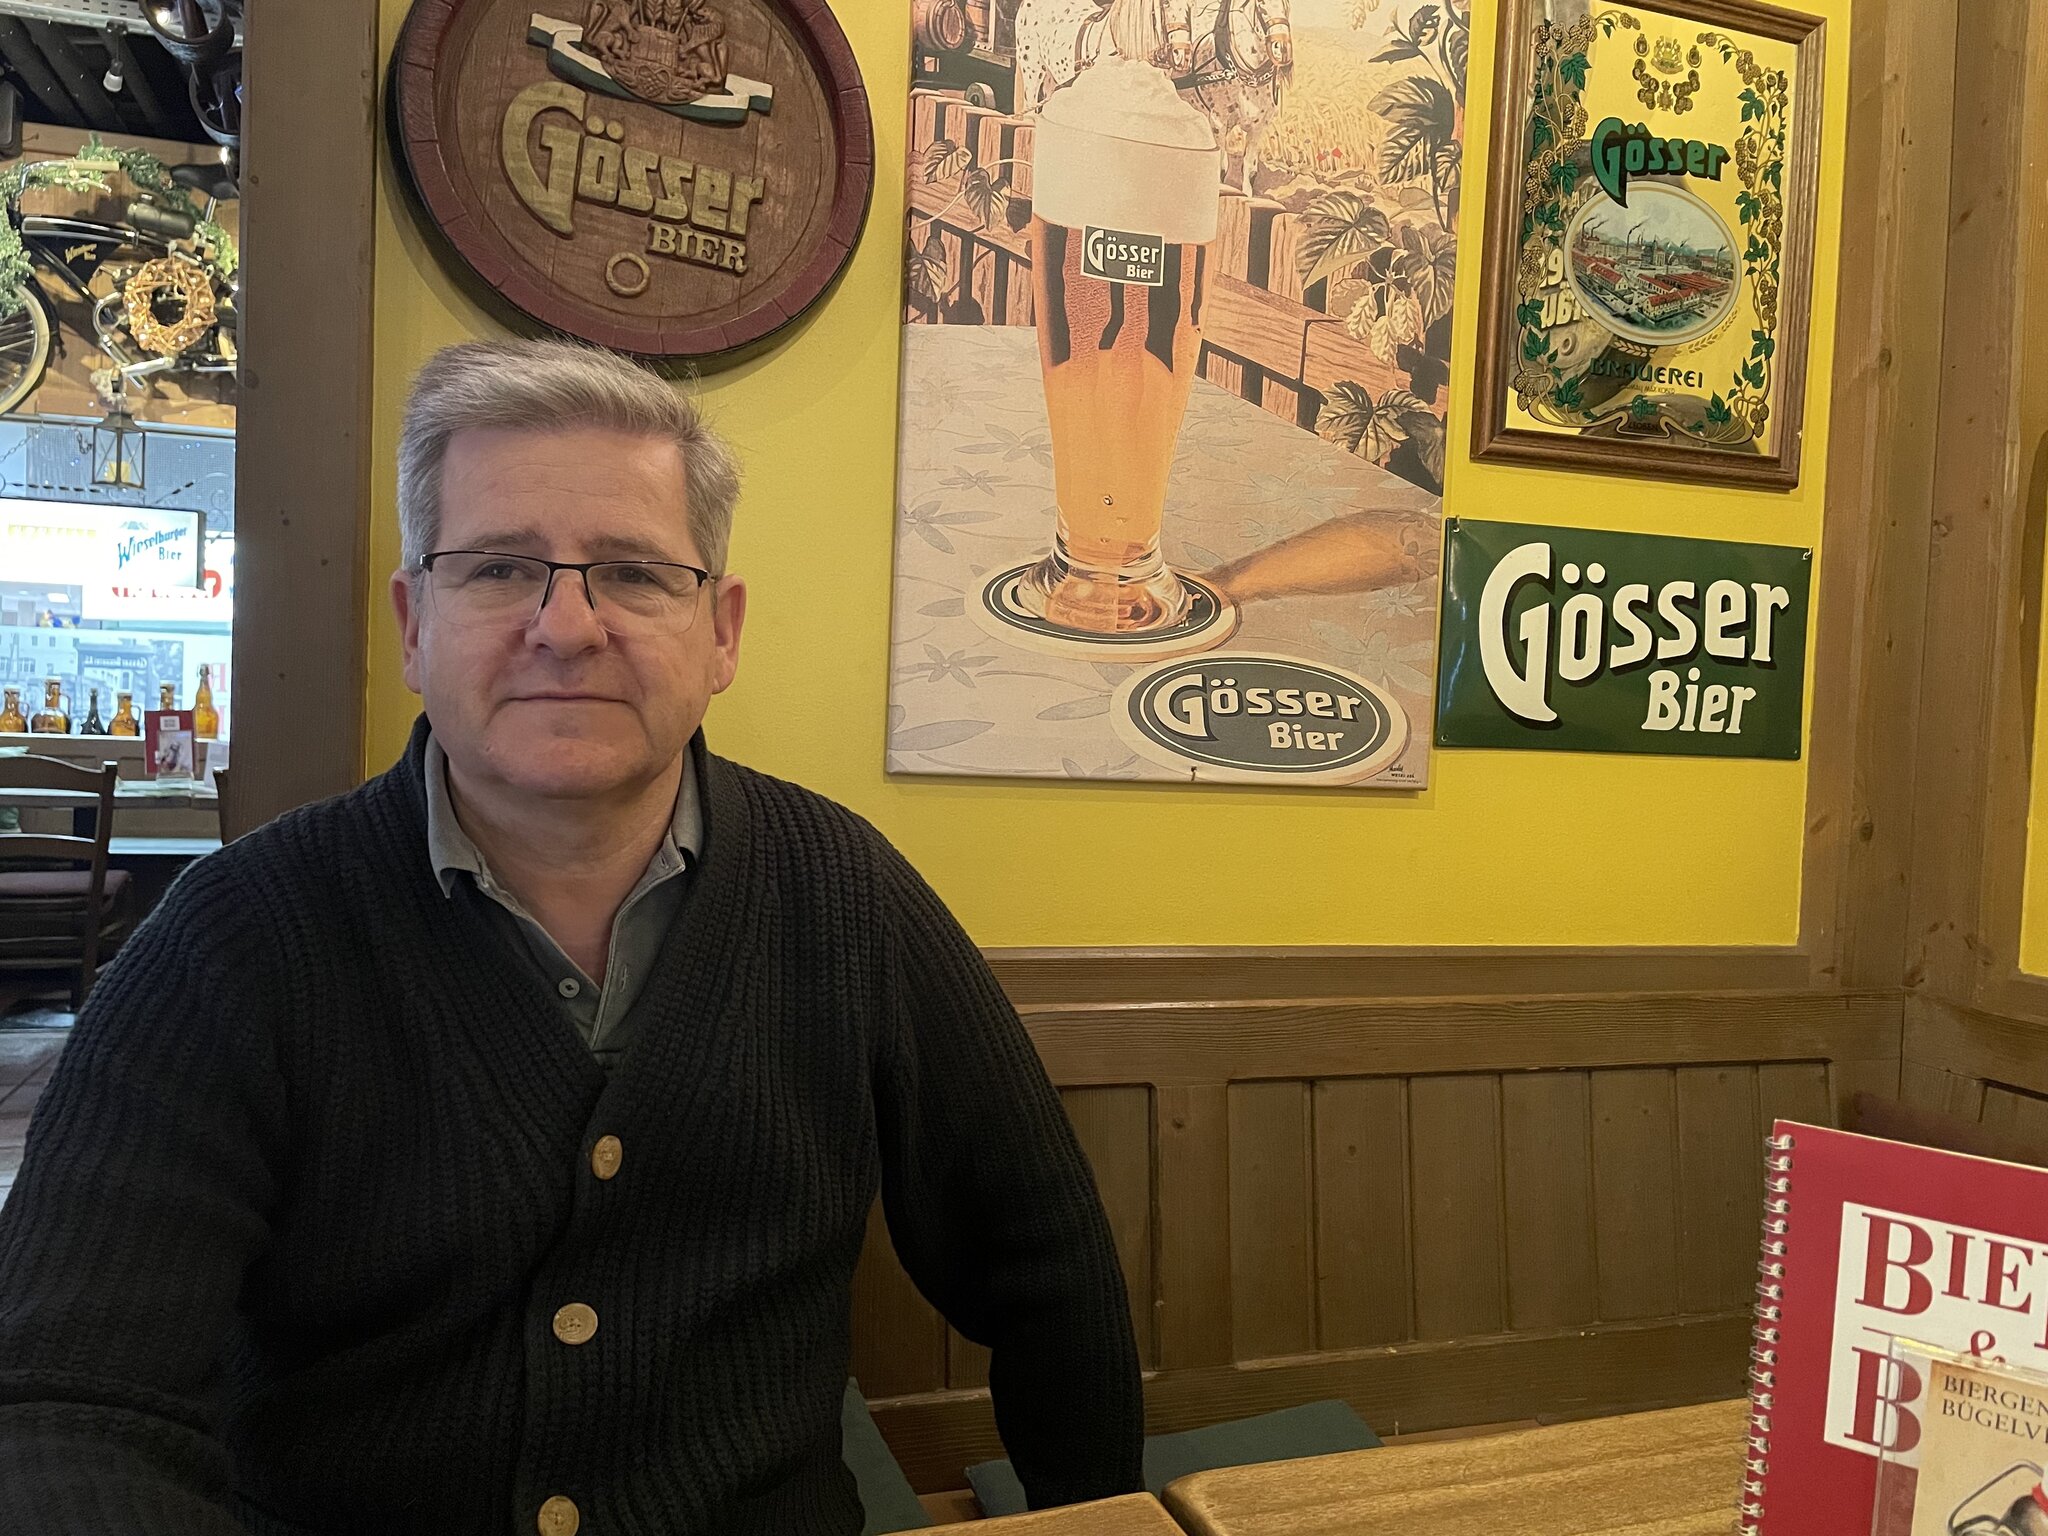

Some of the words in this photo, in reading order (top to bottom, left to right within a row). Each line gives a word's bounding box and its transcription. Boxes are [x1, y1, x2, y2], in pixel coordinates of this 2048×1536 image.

[501, 80, 768, 237] Gösser
[1591, 117, 1730, 205] Gösser
[648, 223, 749, 275] BIER
[1087, 229, 1160, 272] Gösser
[1126, 264, 1155, 279] Bier
[1590, 357, 1703, 388] BRAUEREI
[158, 546, 182, 560] Bier
[1479, 542, 1790, 722] Gösser
[1153, 673, 1362, 738] Gösser
[1640, 666, 1757, 734] Bier
[1267, 721, 1345, 751] Bier
